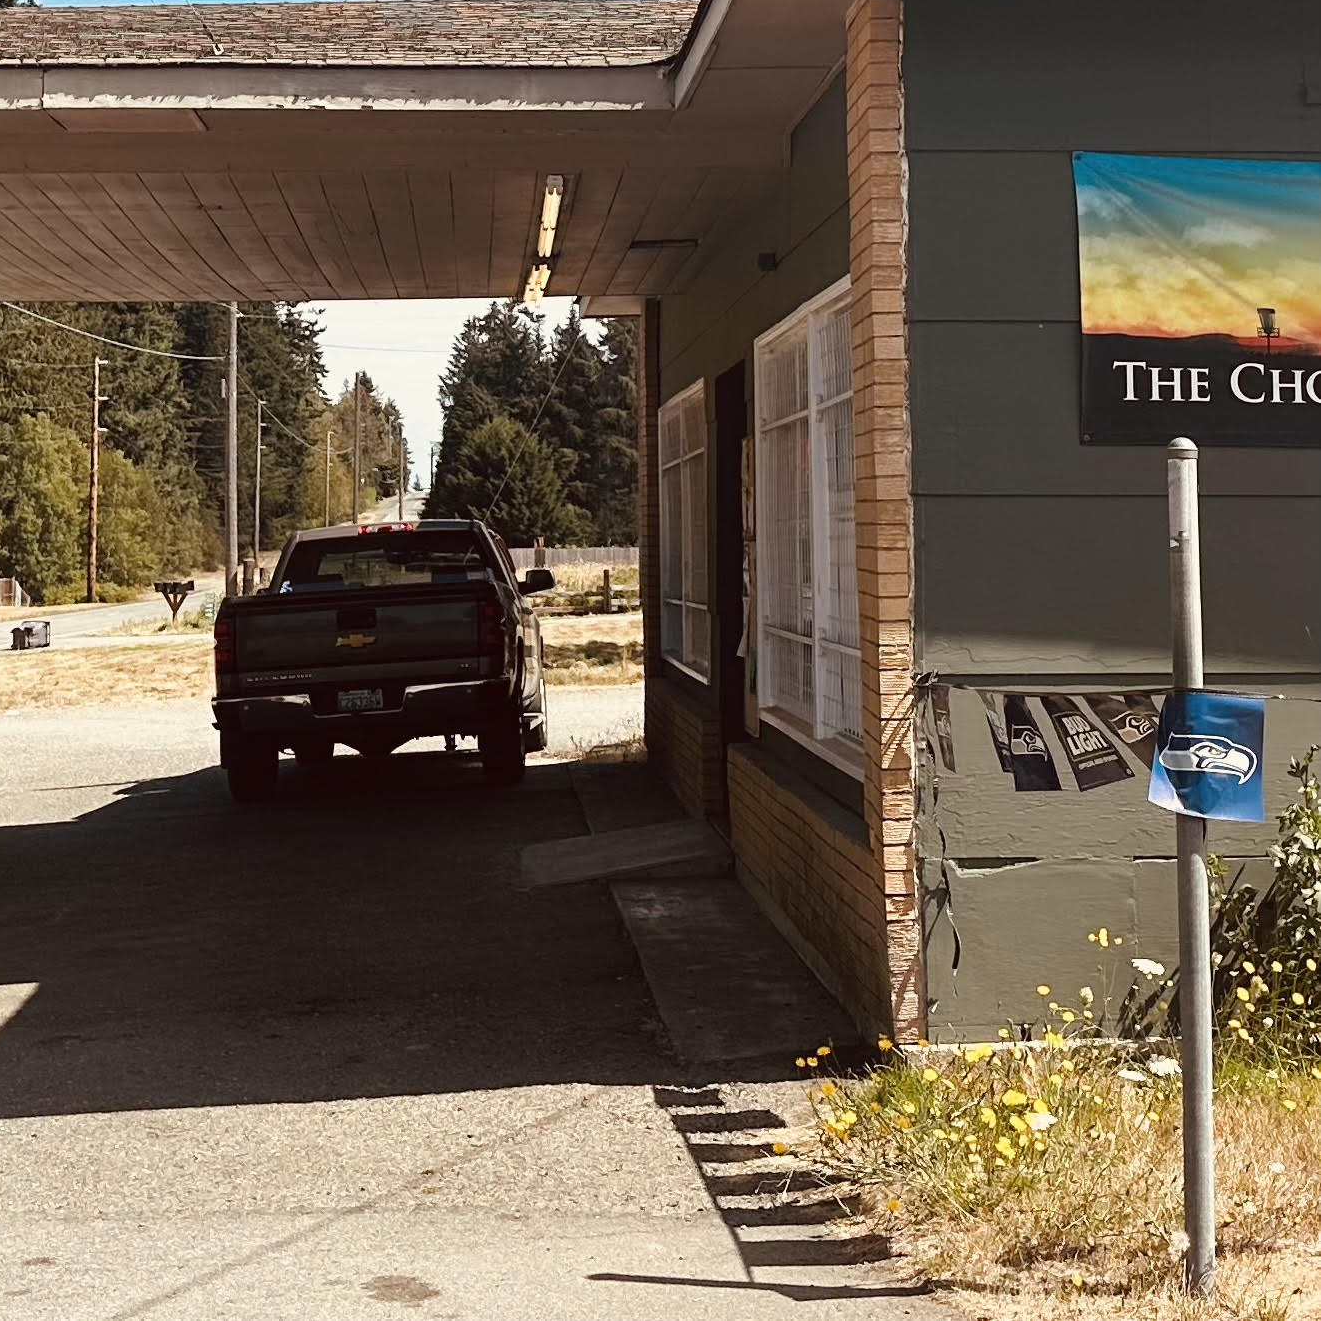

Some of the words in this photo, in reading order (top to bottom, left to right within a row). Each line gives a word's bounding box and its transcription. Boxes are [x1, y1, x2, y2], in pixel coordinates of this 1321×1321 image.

[1112, 361, 1211, 403] THE
[1061, 715, 1091, 736] BUD
[1066, 730, 1109, 756] LIGHT
